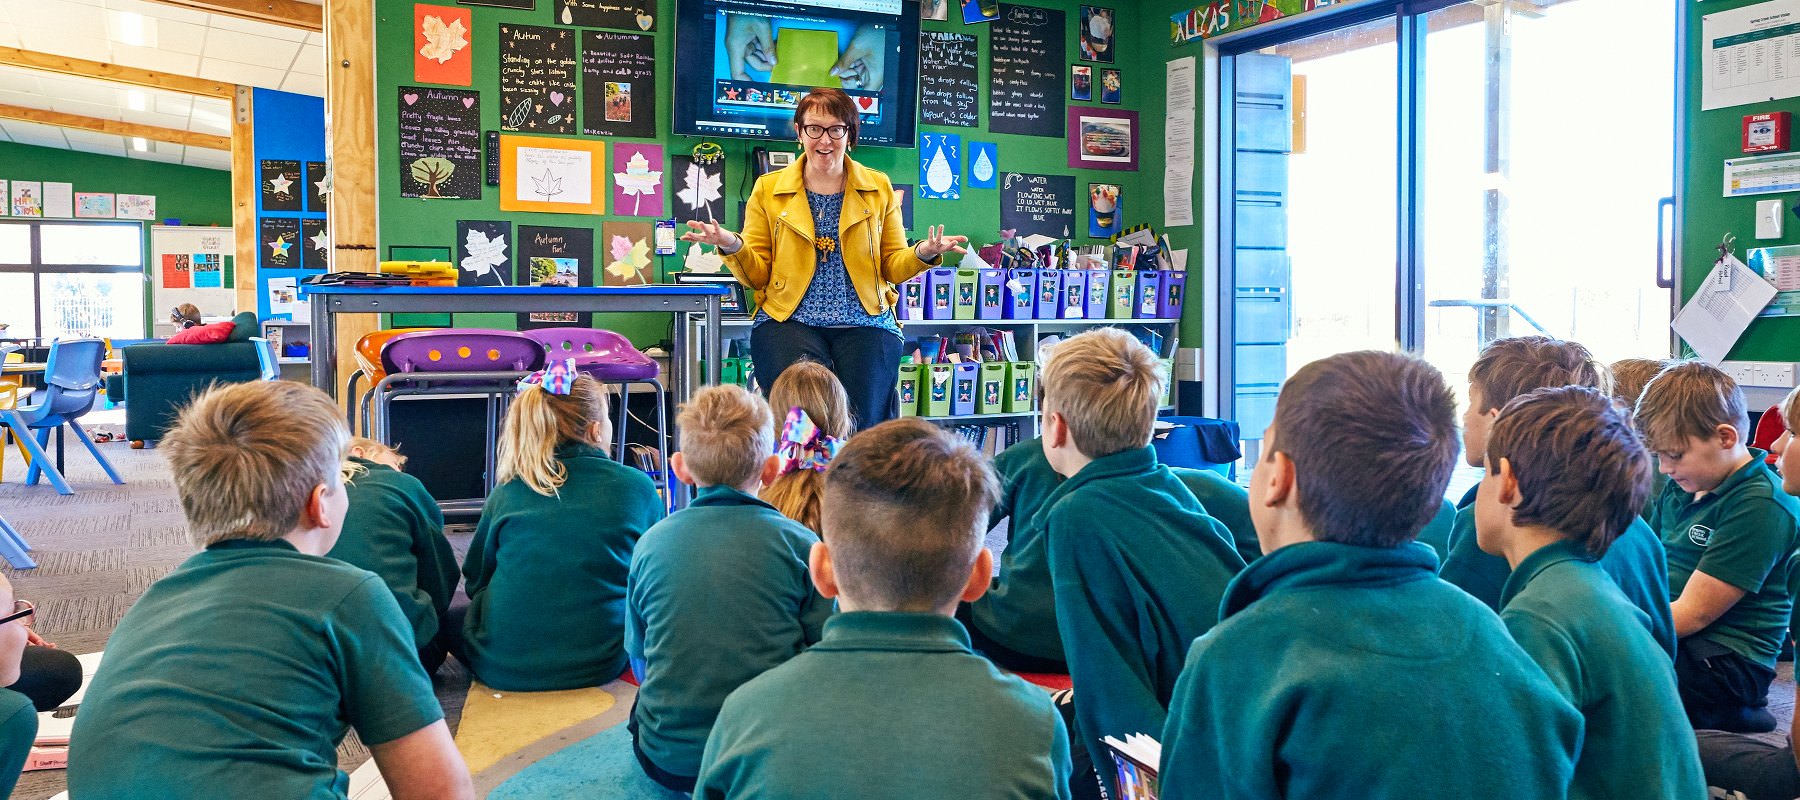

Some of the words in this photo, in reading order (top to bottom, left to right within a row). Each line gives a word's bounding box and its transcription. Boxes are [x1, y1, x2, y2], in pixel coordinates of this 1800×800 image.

[514, 30, 541, 41] Autum
[502, 54, 530, 68] Standing
[427, 89, 459, 101] Autumn
[402, 110, 422, 123] Pretty
[1028, 177, 1047, 185] WATER
[535, 232, 563, 245] Autumn
